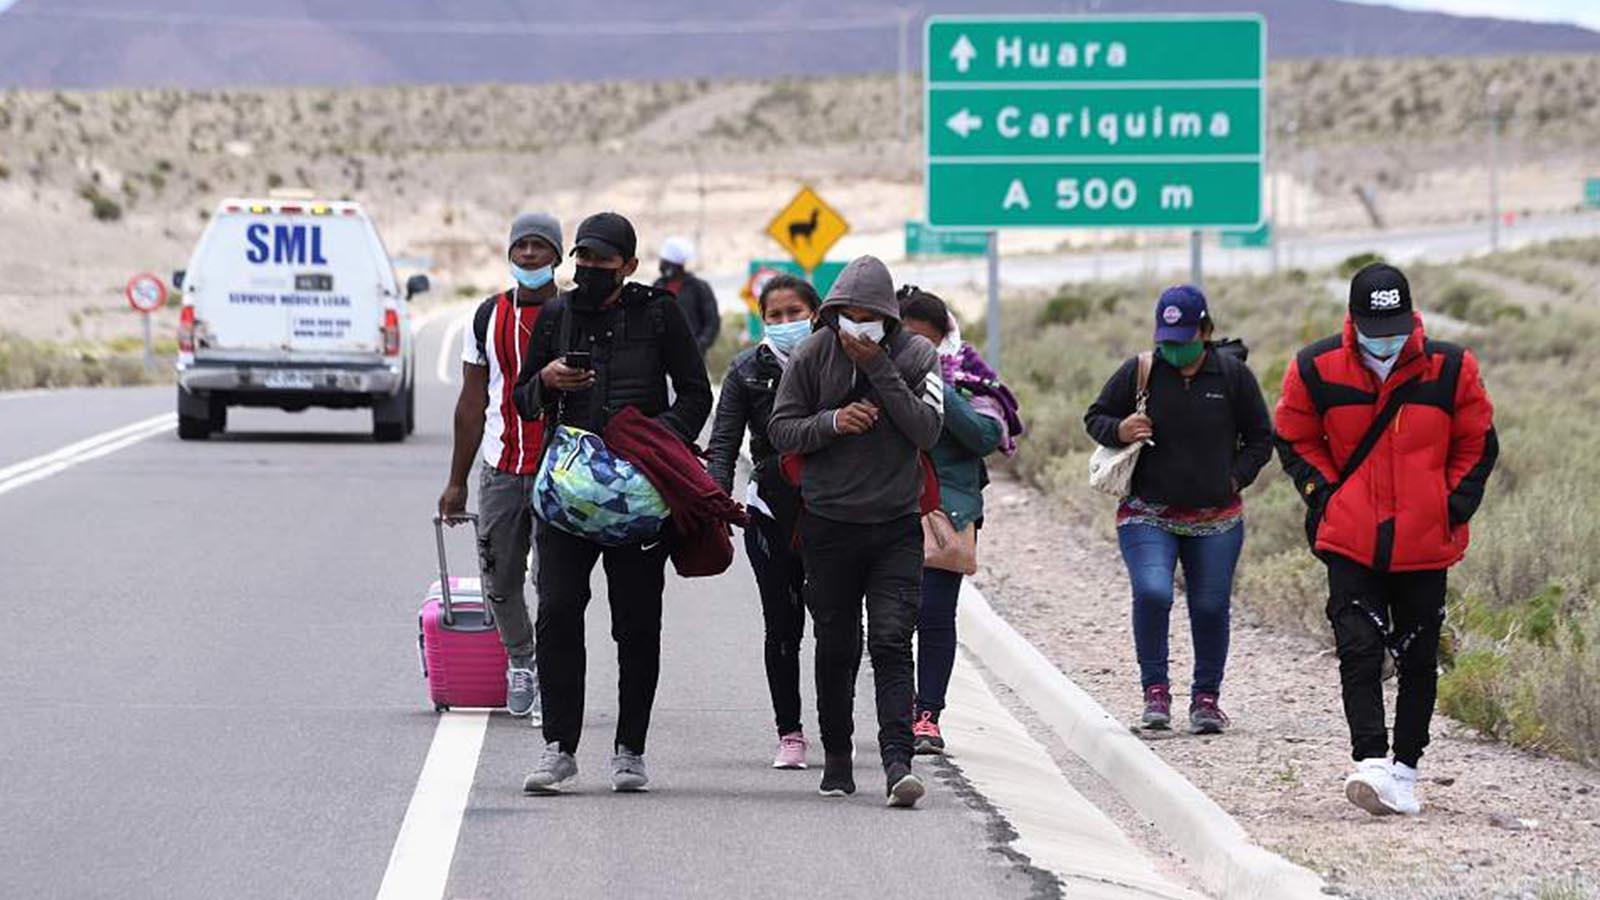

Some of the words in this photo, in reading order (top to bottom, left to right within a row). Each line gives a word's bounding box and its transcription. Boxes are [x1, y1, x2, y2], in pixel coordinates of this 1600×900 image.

[996, 36, 1127, 68] Huara
[996, 105, 1230, 145] Cariquima
[1002, 179, 1030, 210] A
[1056, 178, 1138, 210] 500
[1160, 185, 1193, 209] m
[246, 223, 327, 265] SML
